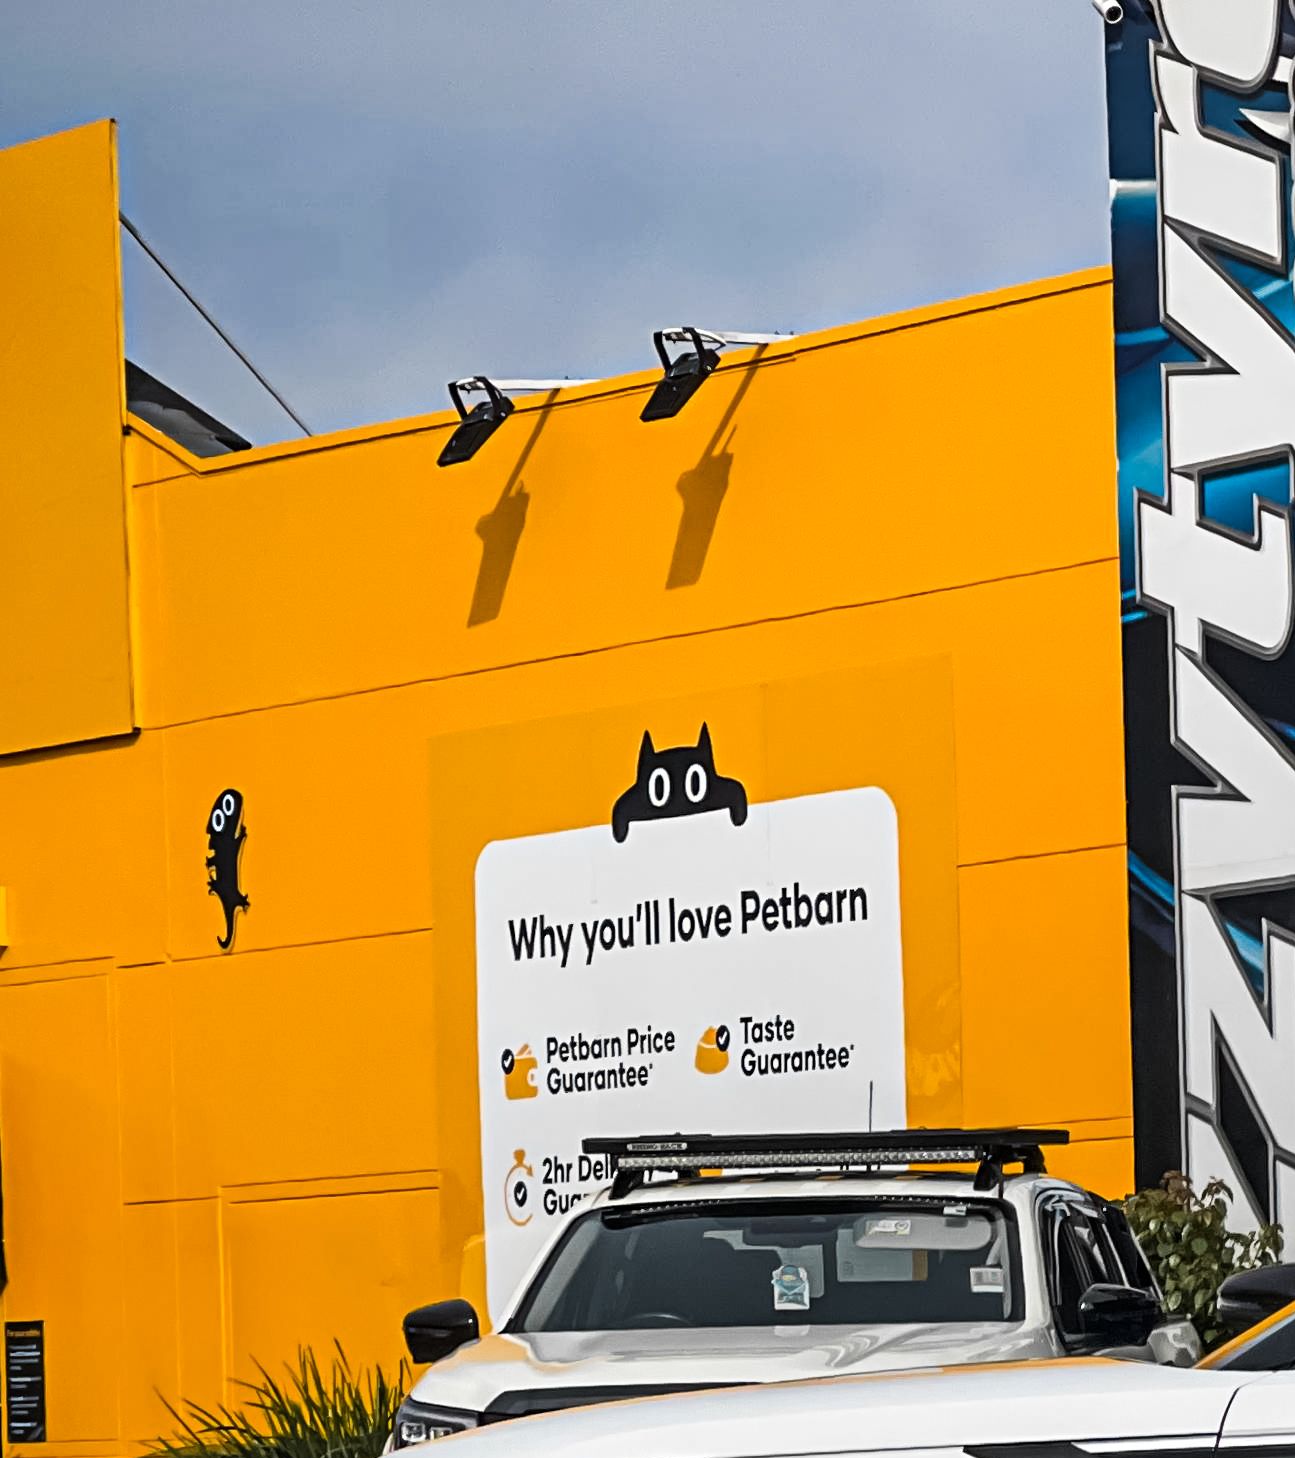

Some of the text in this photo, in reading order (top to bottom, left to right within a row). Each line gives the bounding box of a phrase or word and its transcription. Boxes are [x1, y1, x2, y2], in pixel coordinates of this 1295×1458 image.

[508, 881, 868, 968] Why you'll love Petbarn
[546, 1024, 676, 1063] Petbarn Price
[739, 1014, 795, 1045] Taste
[542, 1155, 573, 1185] 2hr
